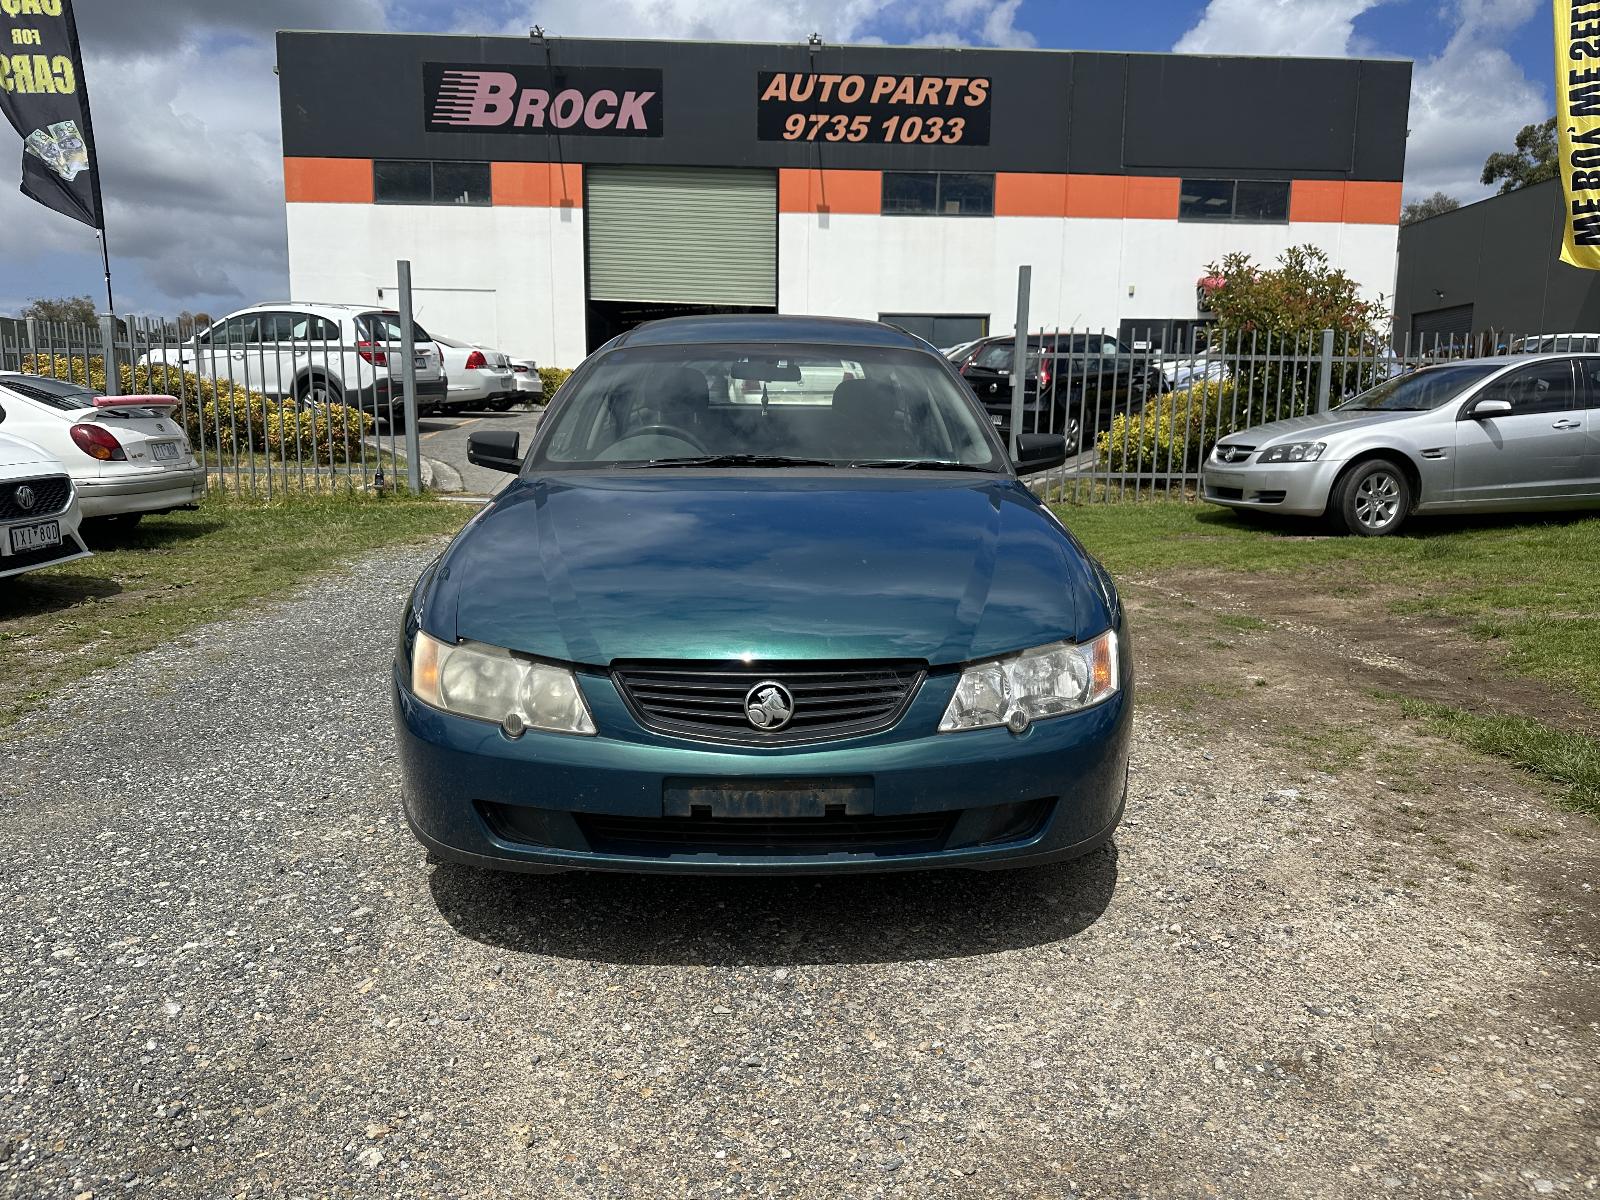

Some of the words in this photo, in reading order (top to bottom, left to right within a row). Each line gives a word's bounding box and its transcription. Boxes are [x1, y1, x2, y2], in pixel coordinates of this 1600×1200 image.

[431, 70, 656, 129] BROCK
[761, 73, 865, 103] AUTO
[869, 76, 990, 107] PARTS
[782, 113, 871, 142] 9735
[882, 115, 966, 144] 1033
